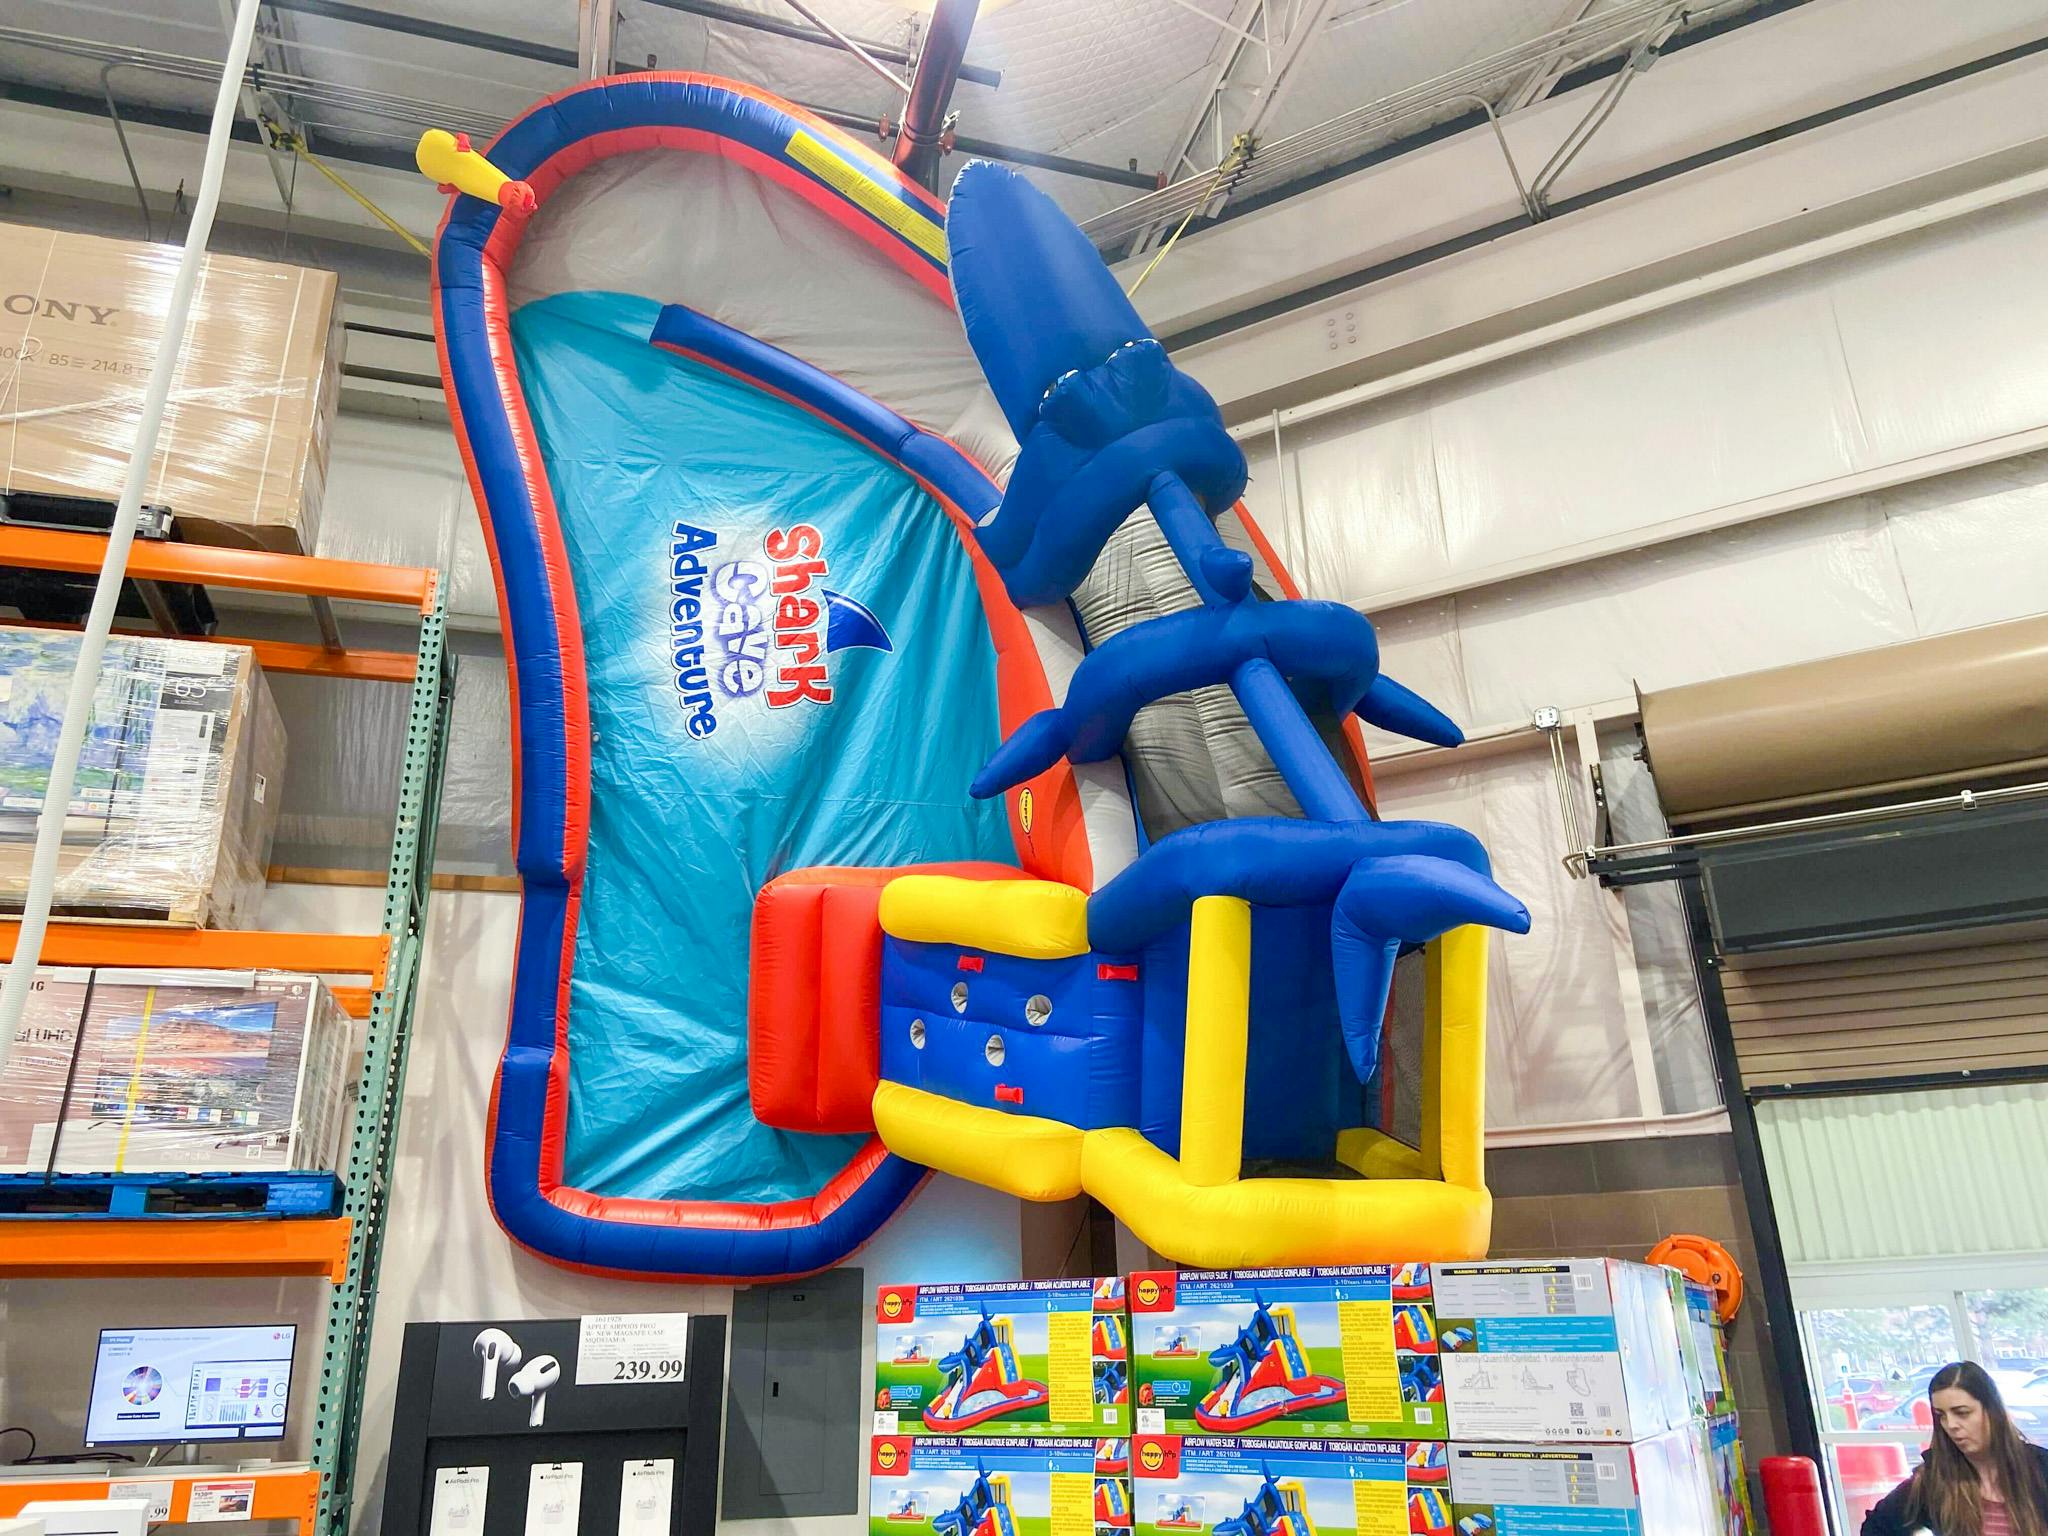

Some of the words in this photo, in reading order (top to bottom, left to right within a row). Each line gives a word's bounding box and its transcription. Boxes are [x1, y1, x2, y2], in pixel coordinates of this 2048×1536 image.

[764, 523, 834, 710] Shark
[670, 520, 718, 739] Adventure
[711, 561, 769, 698] Cave
[1180, 1272, 1199, 1280] AIRFLOW
[1200, 1272, 1215, 1280] WATER
[1216, 1271, 1229, 1279] SLIDE
[1234, 1270, 1258, 1279] TOBOGGAN
[1259, 1269, 1284, 1278] AQUATIQUE
[1284, 1268, 1310, 1277] GONFLABLE
[1363, 1265, 1386, 1275] INFLABLE
[613, 1360, 682, 1380] 239.99
[1142, 1451, 1162, 1459] happy
[1184, 1438, 1205, 1446] AIRFLOW
[1206, 1438, 1221, 1447] WATER
[1222, 1439, 1235, 1447] SLIDE
[1241, 1439, 1267, 1448] TOBOGGAN
[1267, 1440, 1294, 1449] AQUATIQUE
[1294, 1441, 1322, 1450] GONFLABLE
[1377, 1443, 1401, 1453] INFLABLE
